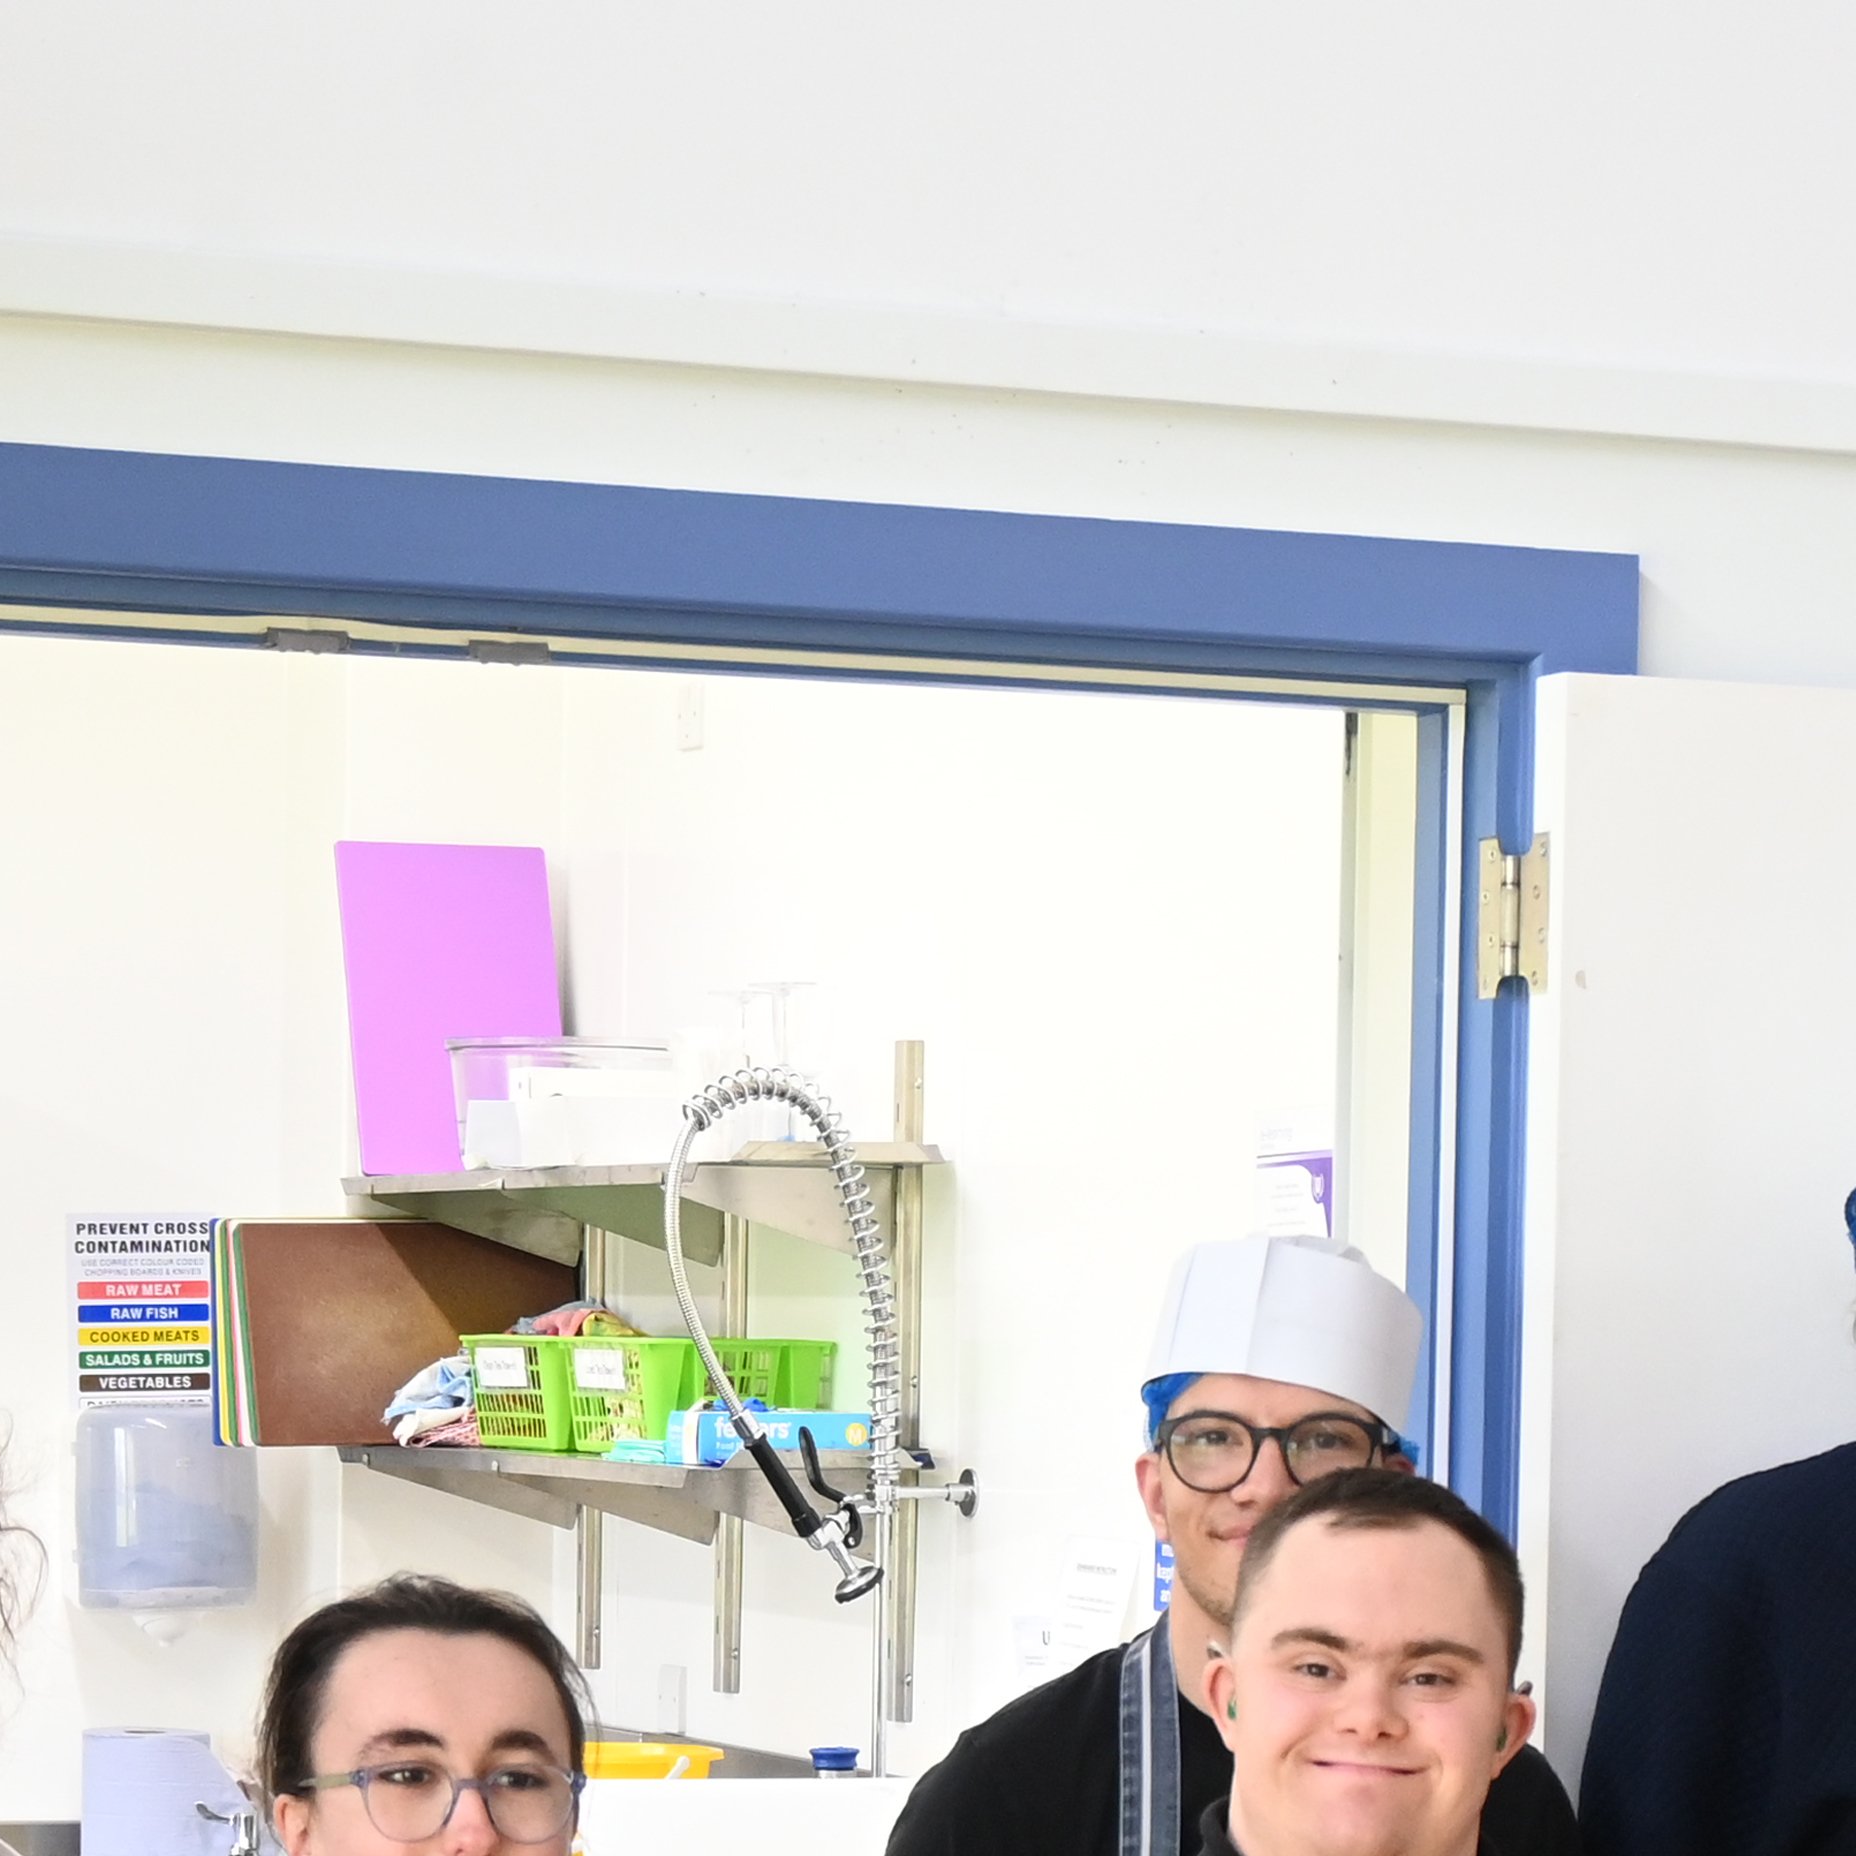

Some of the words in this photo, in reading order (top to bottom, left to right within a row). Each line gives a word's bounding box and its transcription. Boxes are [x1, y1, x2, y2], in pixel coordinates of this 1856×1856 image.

[76, 1222, 148, 1236] PREVENT
[154, 1221, 208, 1235] CROSS
[74, 1239, 211, 1254] CONTAMINATION
[140, 1257, 174, 1267] COLOUR
[84, 1268, 129, 1277] CHOPPING
[130, 1268, 163, 1276] BOARDS
[105, 1284, 139, 1296] RAW
[141, 1283, 182, 1296] MEAT
[110, 1308, 143, 1320] RAW
[146, 1307, 179, 1319] FISH
[89, 1331, 150, 1343] COOKED
[153, 1330, 200, 1342] MEATS
[85, 1354, 140, 1366] SALADS
[143, 1354, 152, 1365] &
[155, 1353, 204, 1365] FRUITS
[99, 1376, 191, 1389] VEGETABLES
[848, 1428, 863, 1440] M
